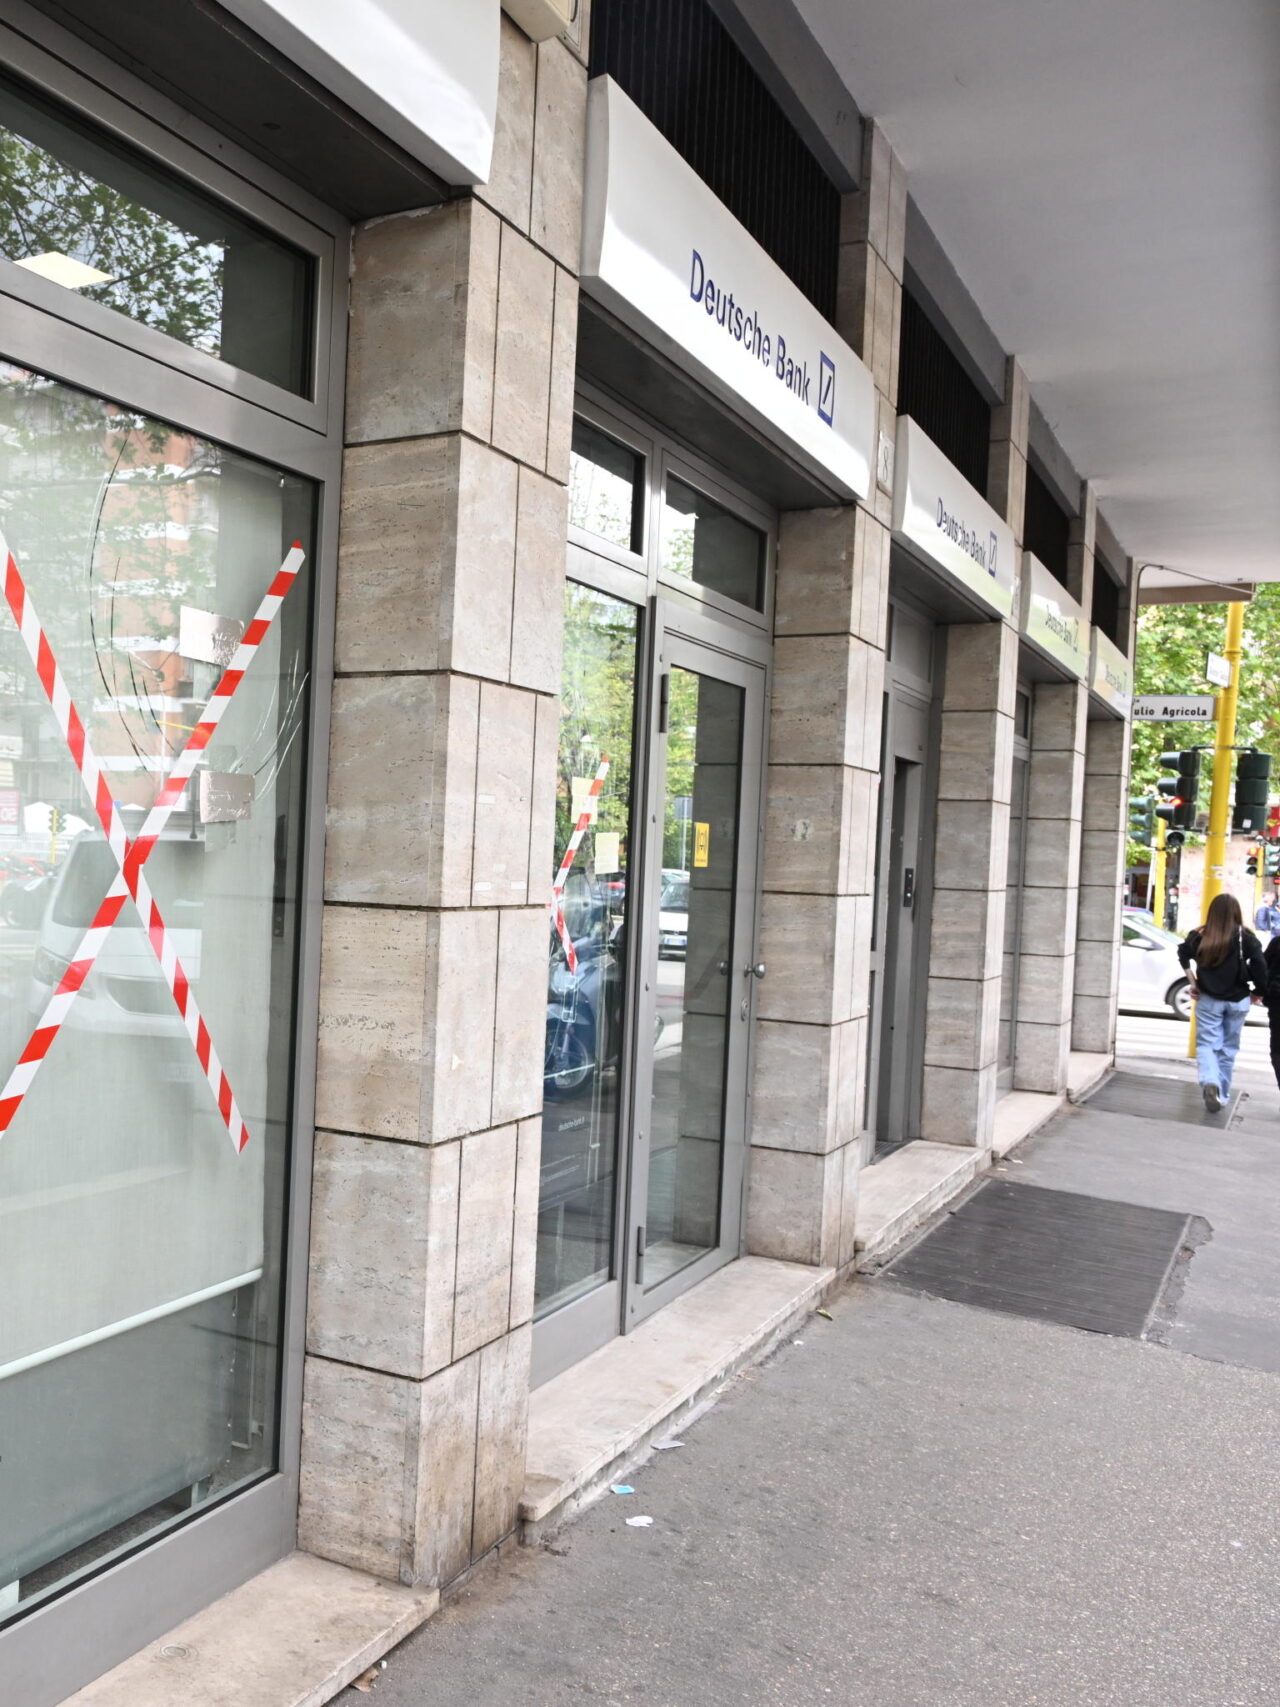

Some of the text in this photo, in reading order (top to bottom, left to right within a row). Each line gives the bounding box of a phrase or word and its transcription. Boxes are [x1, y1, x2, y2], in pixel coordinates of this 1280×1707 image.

[690, 249, 810, 406] Deutsche Bank
[937, 497, 987, 568] Deutsche Bank
[1134, 706, 1207, 718] ulio Agricola
